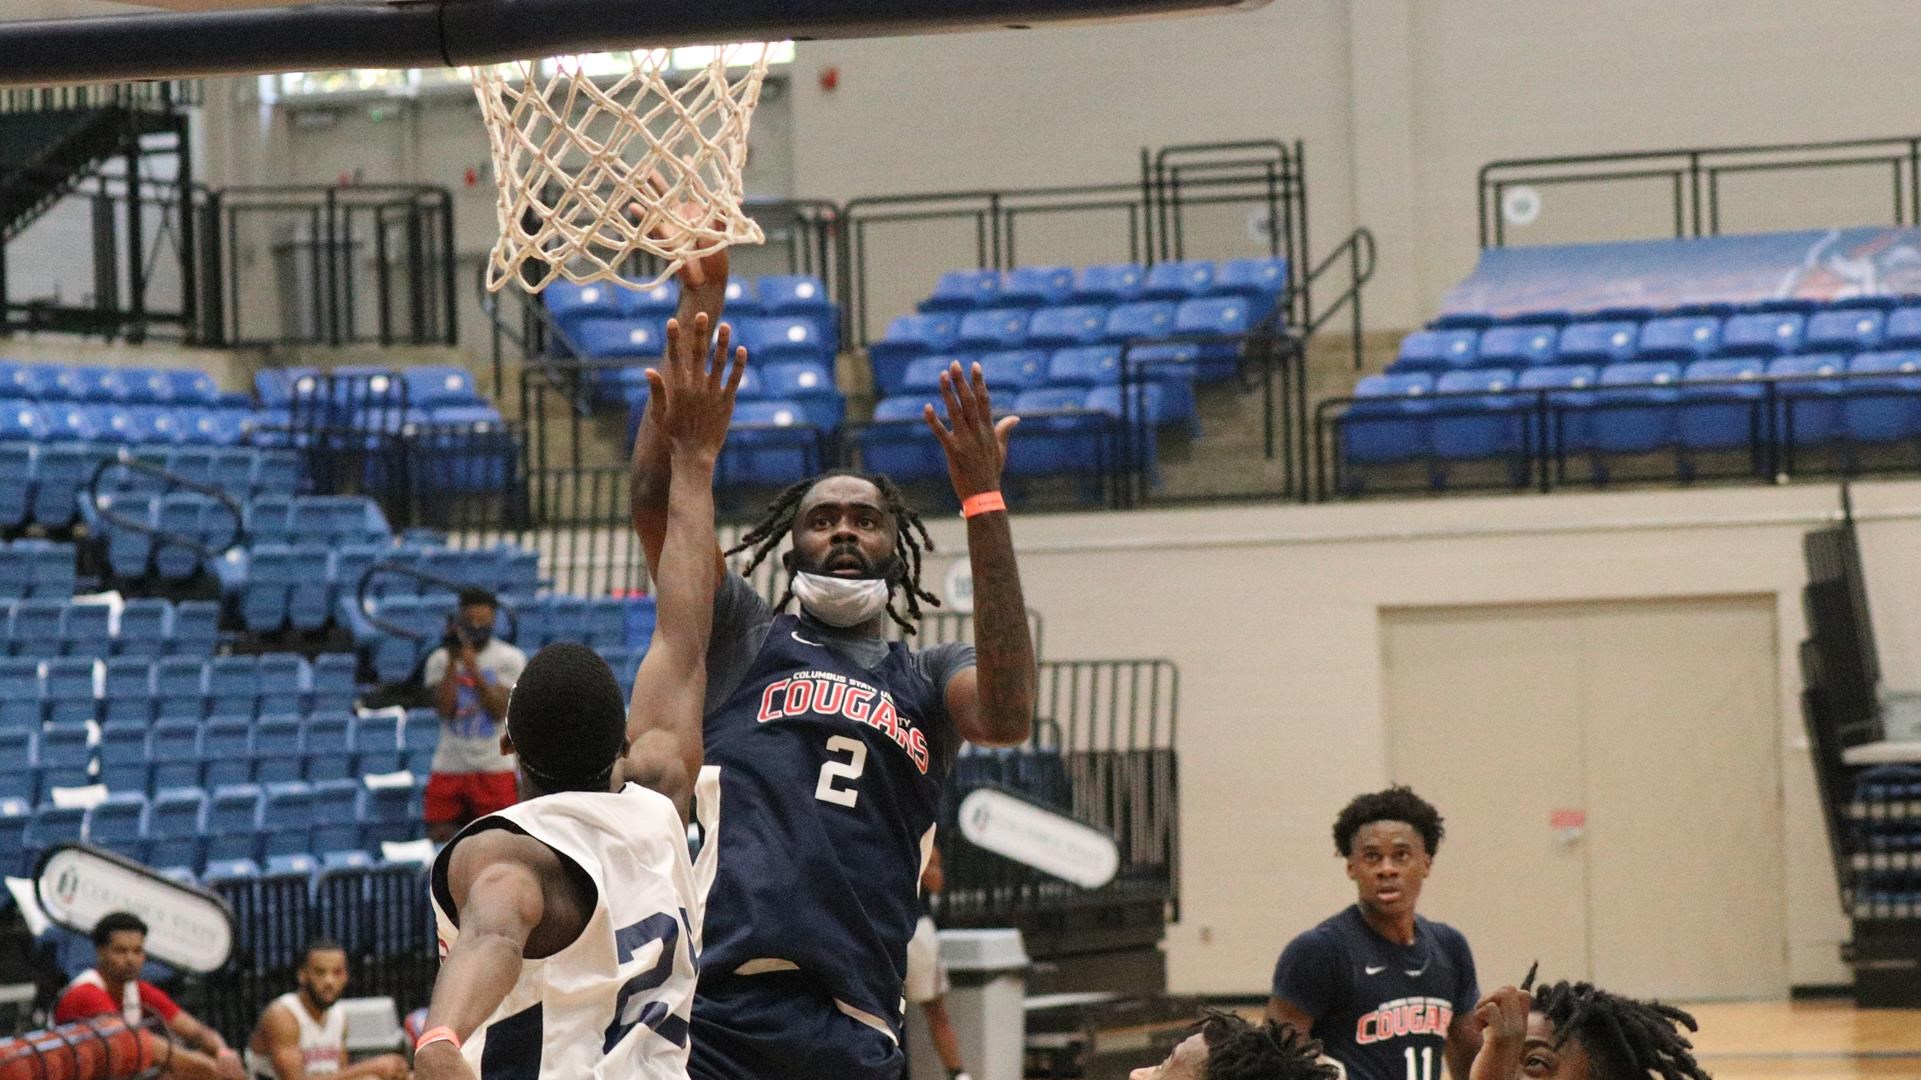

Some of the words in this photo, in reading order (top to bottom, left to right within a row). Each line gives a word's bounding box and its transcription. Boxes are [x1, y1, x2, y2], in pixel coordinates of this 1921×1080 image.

[793, 671, 846, 682] COLUMBUS
[815, 735, 868, 808] 2
[1404, 1047, 1433, 1080] 11
